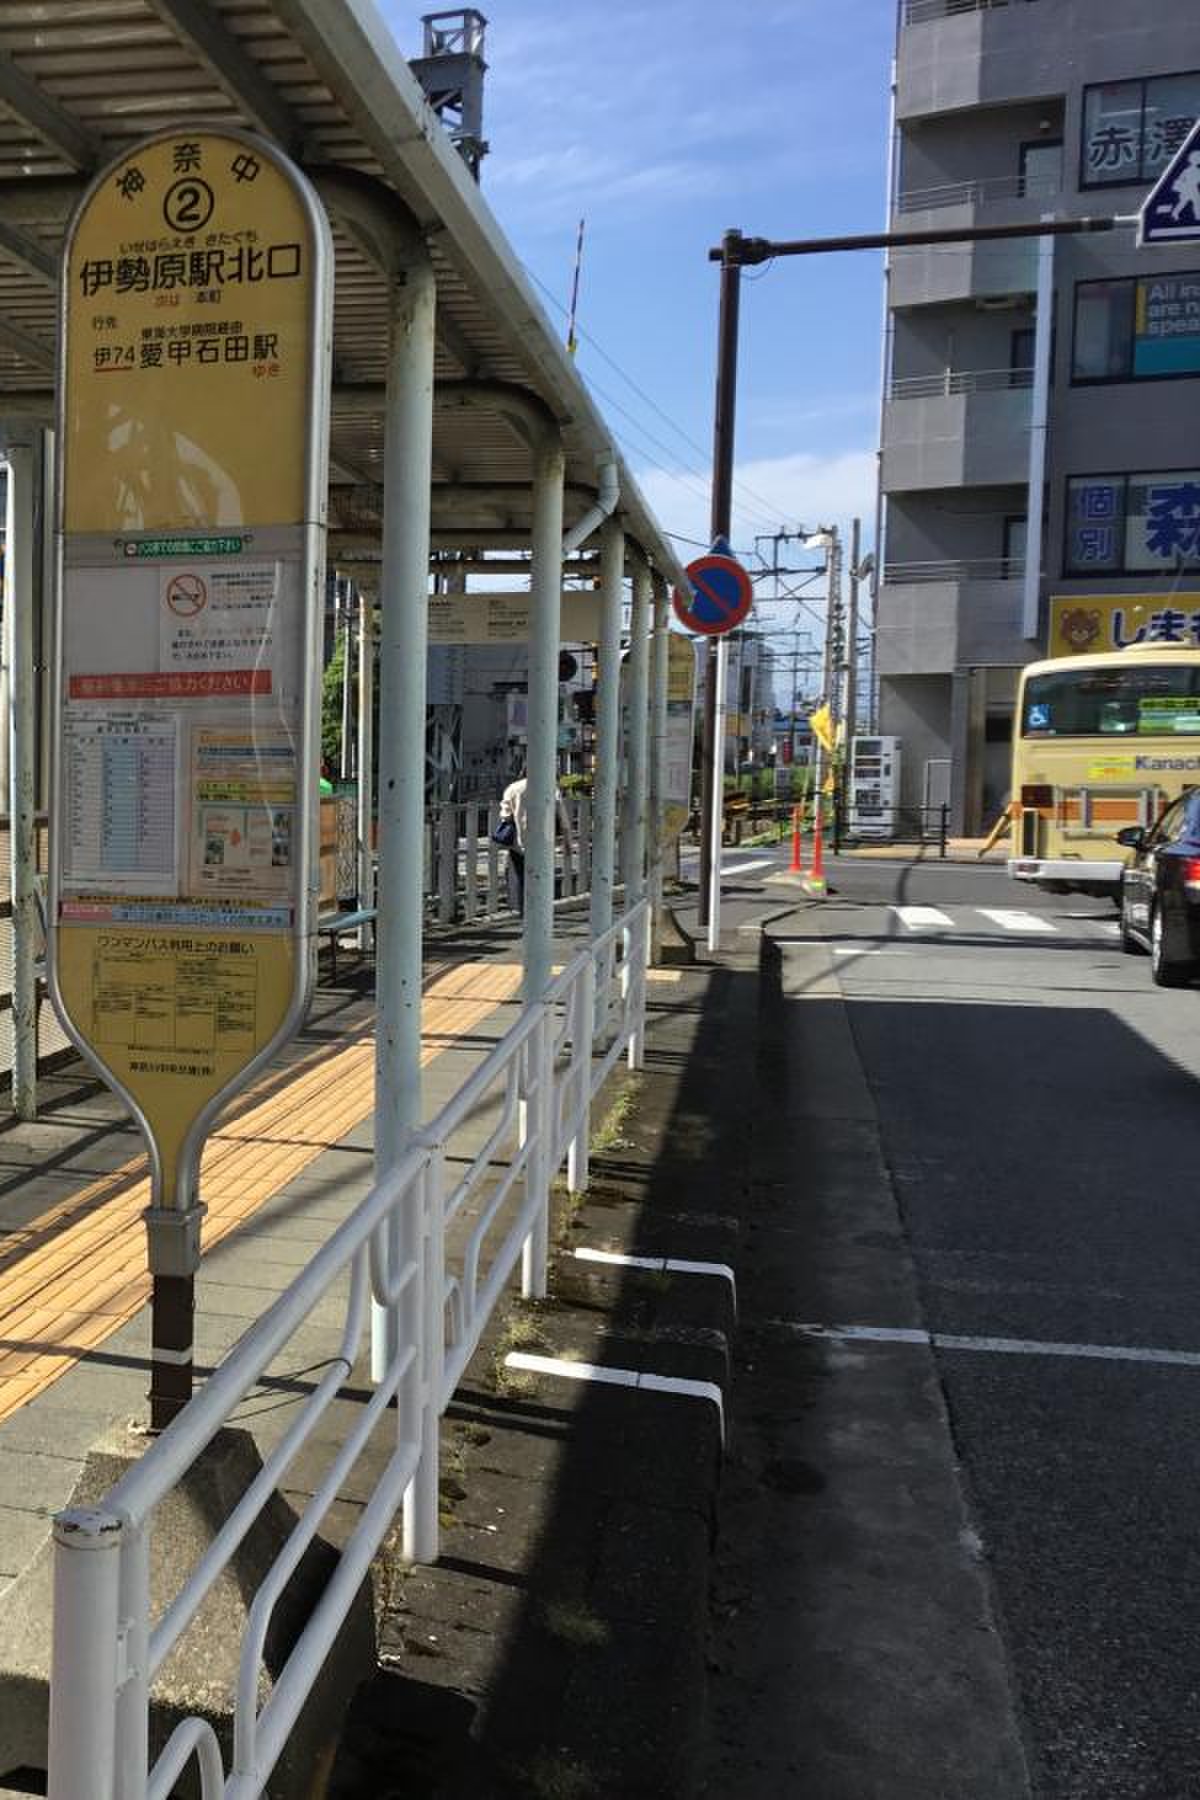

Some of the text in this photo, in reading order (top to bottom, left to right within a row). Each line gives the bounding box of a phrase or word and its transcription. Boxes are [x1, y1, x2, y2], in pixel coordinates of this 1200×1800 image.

[116, 143, 261, 201] 神奈中
[79, 244, 301, 297] 伊勢原駅北口
[93, 334, 278, 369] 伊74 愛甲石田駅
[1136, 755, 1200, 769] Kanac
